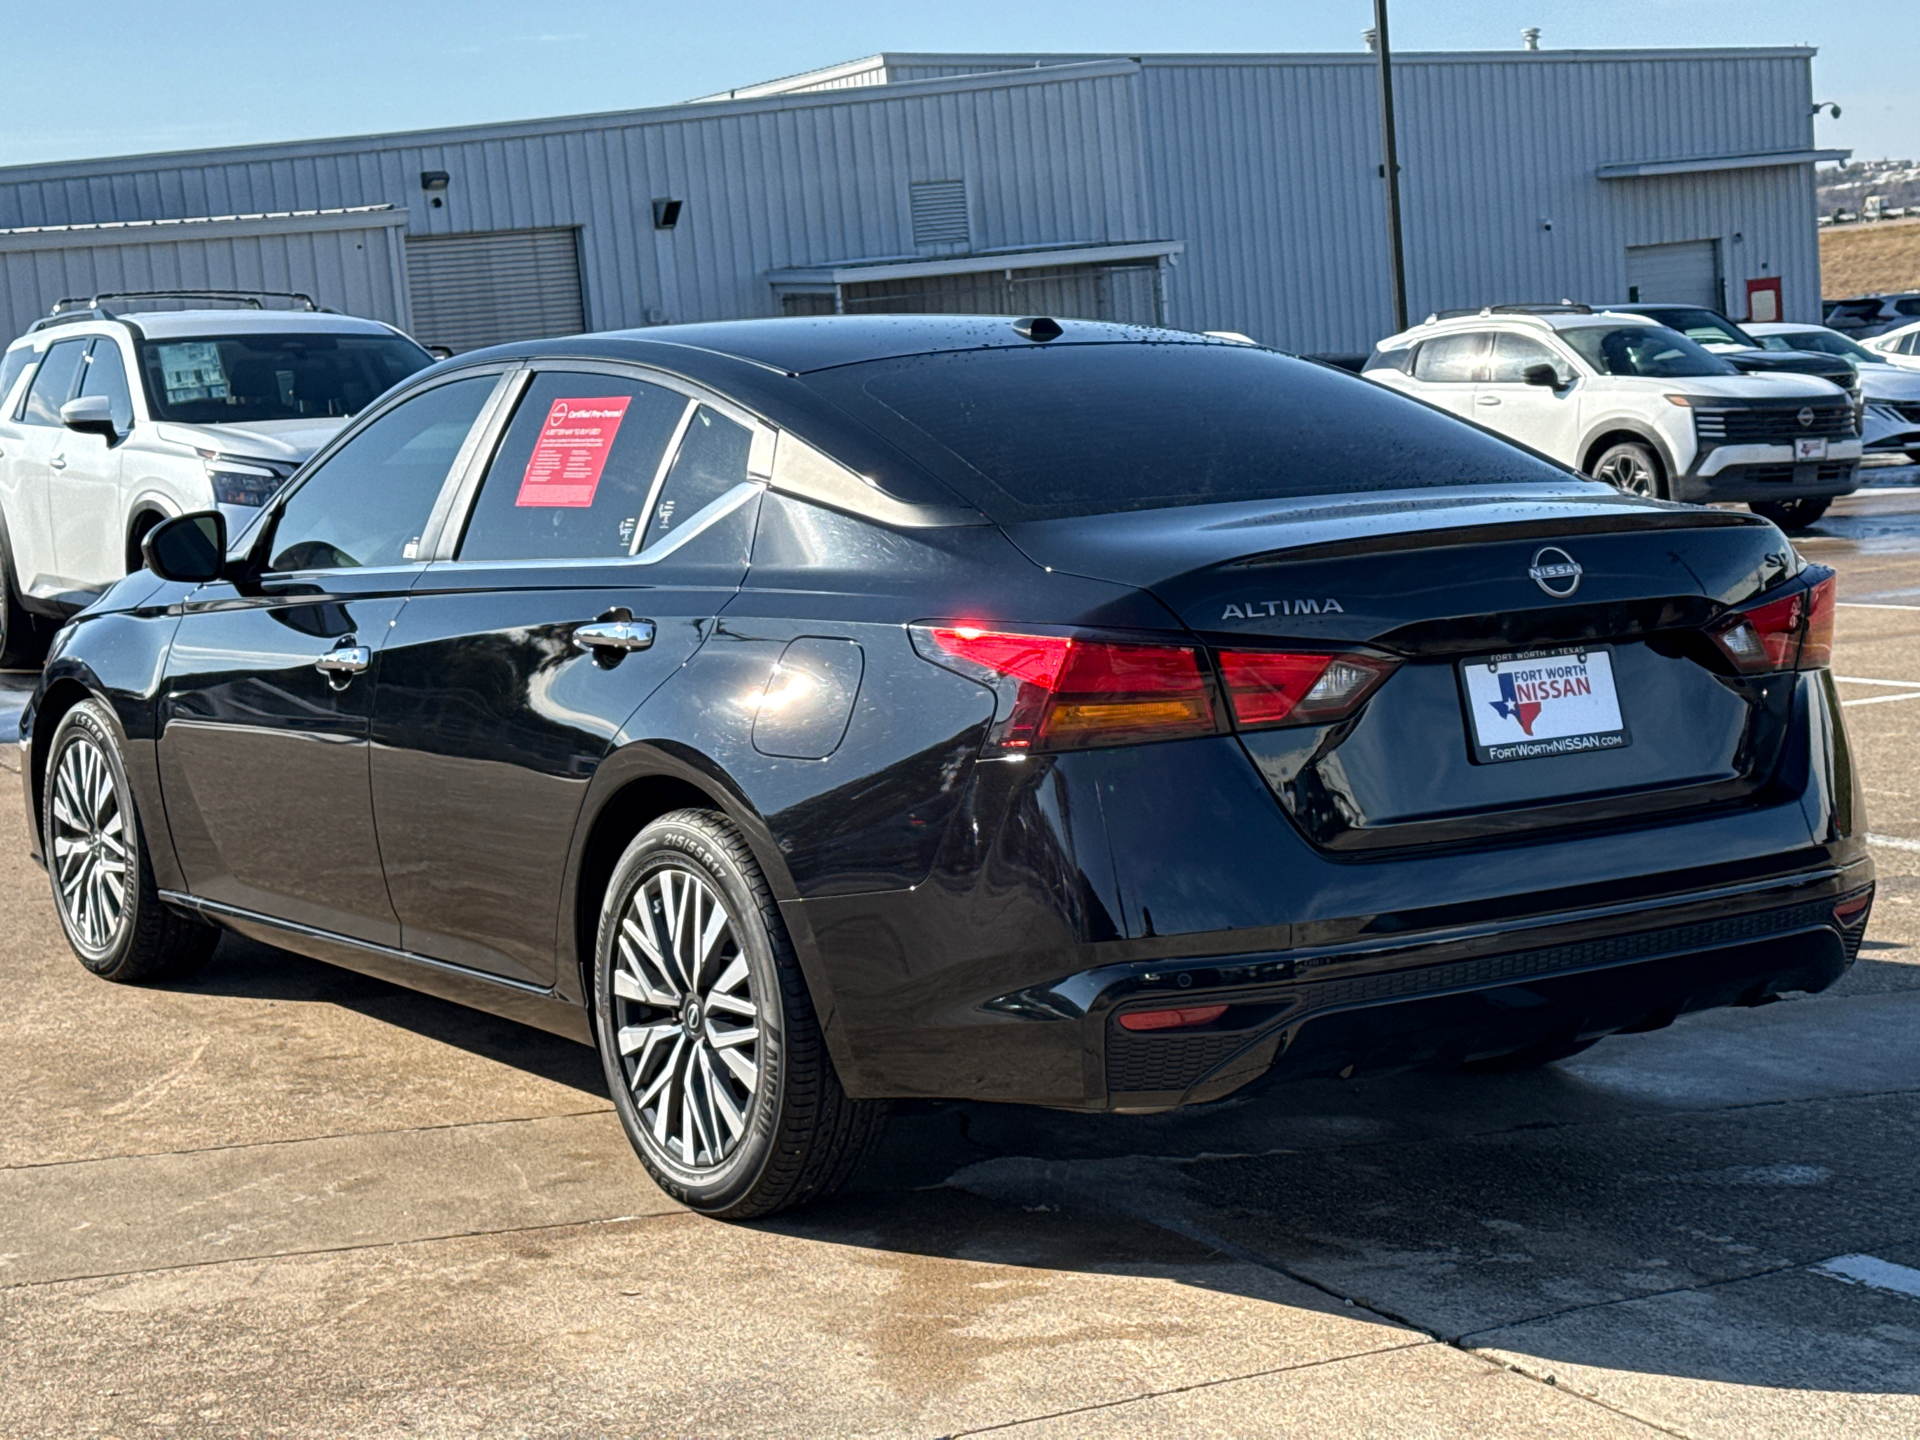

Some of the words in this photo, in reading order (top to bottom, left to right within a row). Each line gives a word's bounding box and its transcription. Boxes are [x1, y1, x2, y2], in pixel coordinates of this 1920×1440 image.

[1529, 564, 1583, 577] NISSAN
[1220, 598, 1345, 620] ALTIMA
[1490, 652, 1513, 662] FORT
[1516, 649, 1547, 660] WORTH
[1557, 645, 1585, 656] TEXAS
[1514, 668, 1544, 683] FORT
[1545, 664, 1588, 680] WORTH
[1516, 676, 1592, 703] NISSAN
[662, 832, 727, 879] 215/55R17
